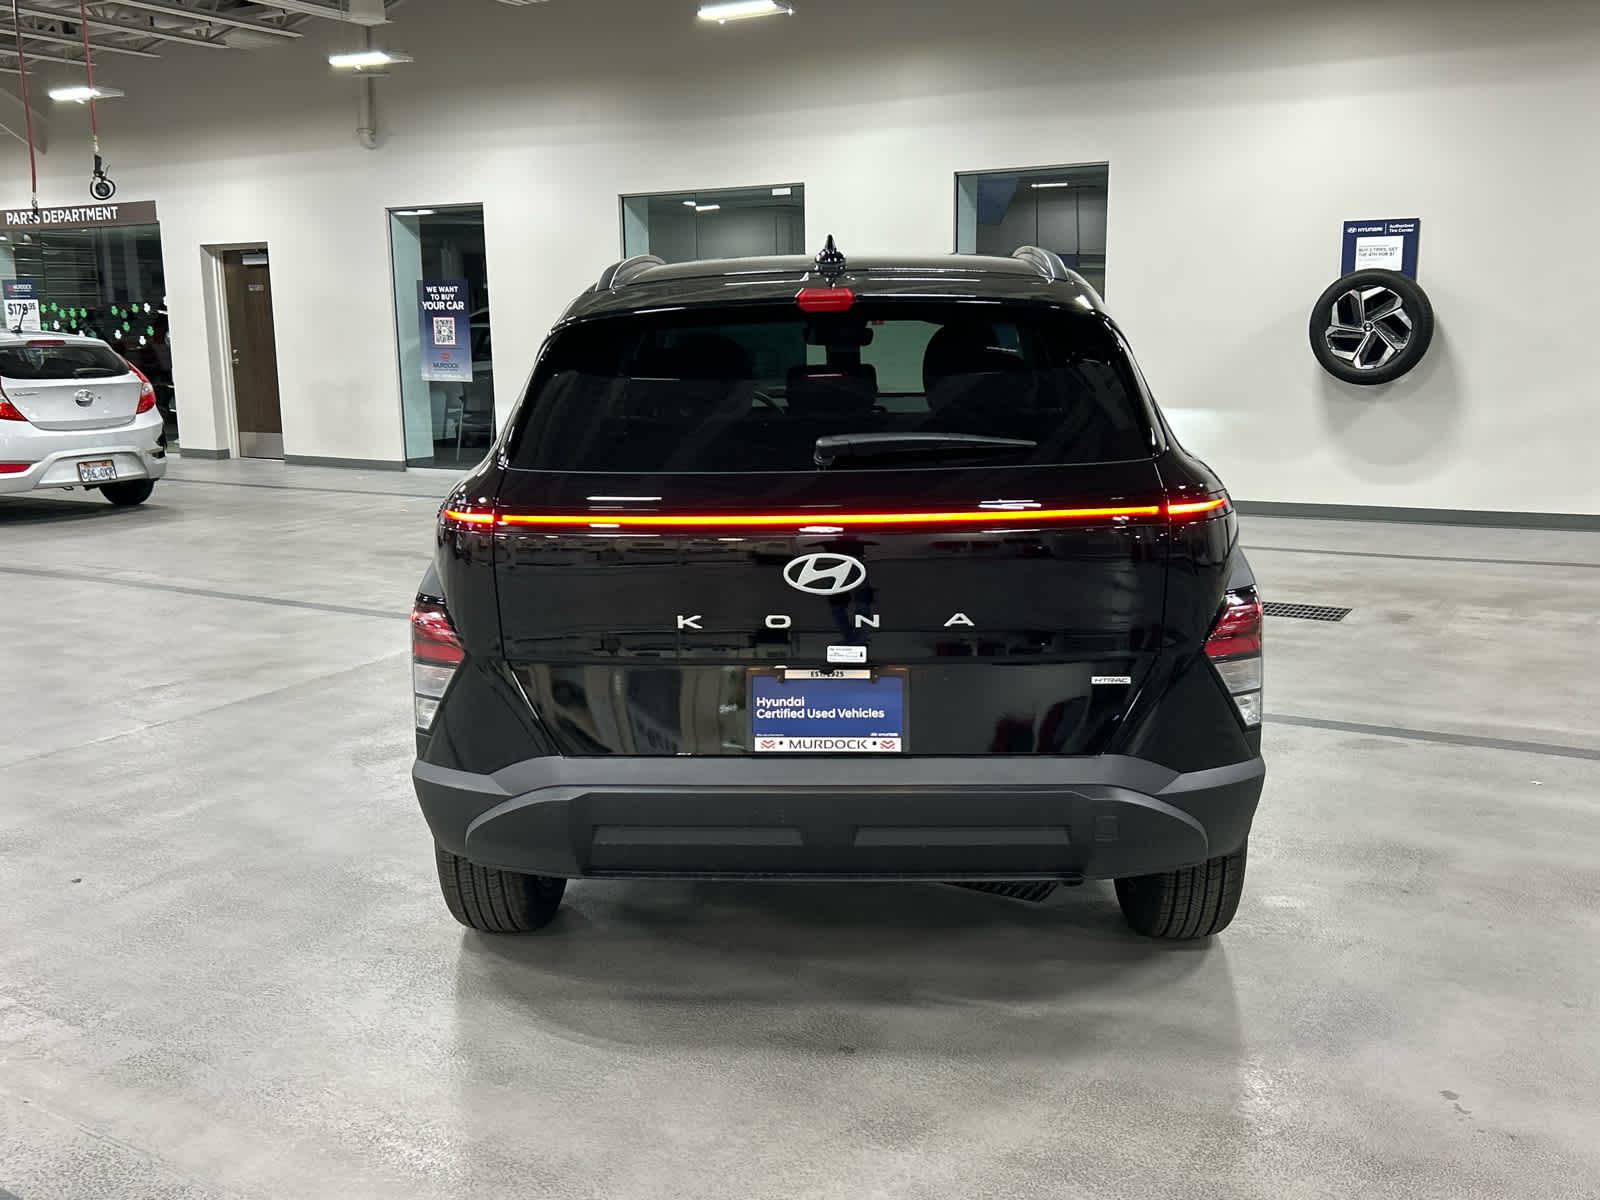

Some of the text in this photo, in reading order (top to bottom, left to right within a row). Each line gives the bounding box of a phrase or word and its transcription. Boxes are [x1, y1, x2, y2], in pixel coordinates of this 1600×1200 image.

[6, 206, 118, 225] PARTS DEPARTMENT
[441, 293, 455, 301] BUY
[422, 301, 465, 311] YOUR CAR
[756, 696, 805, 708] Hyundai
[756, 708, 885, 719] Certified Used Vehicles
[788, 739, 868, 749] MURDOCK
